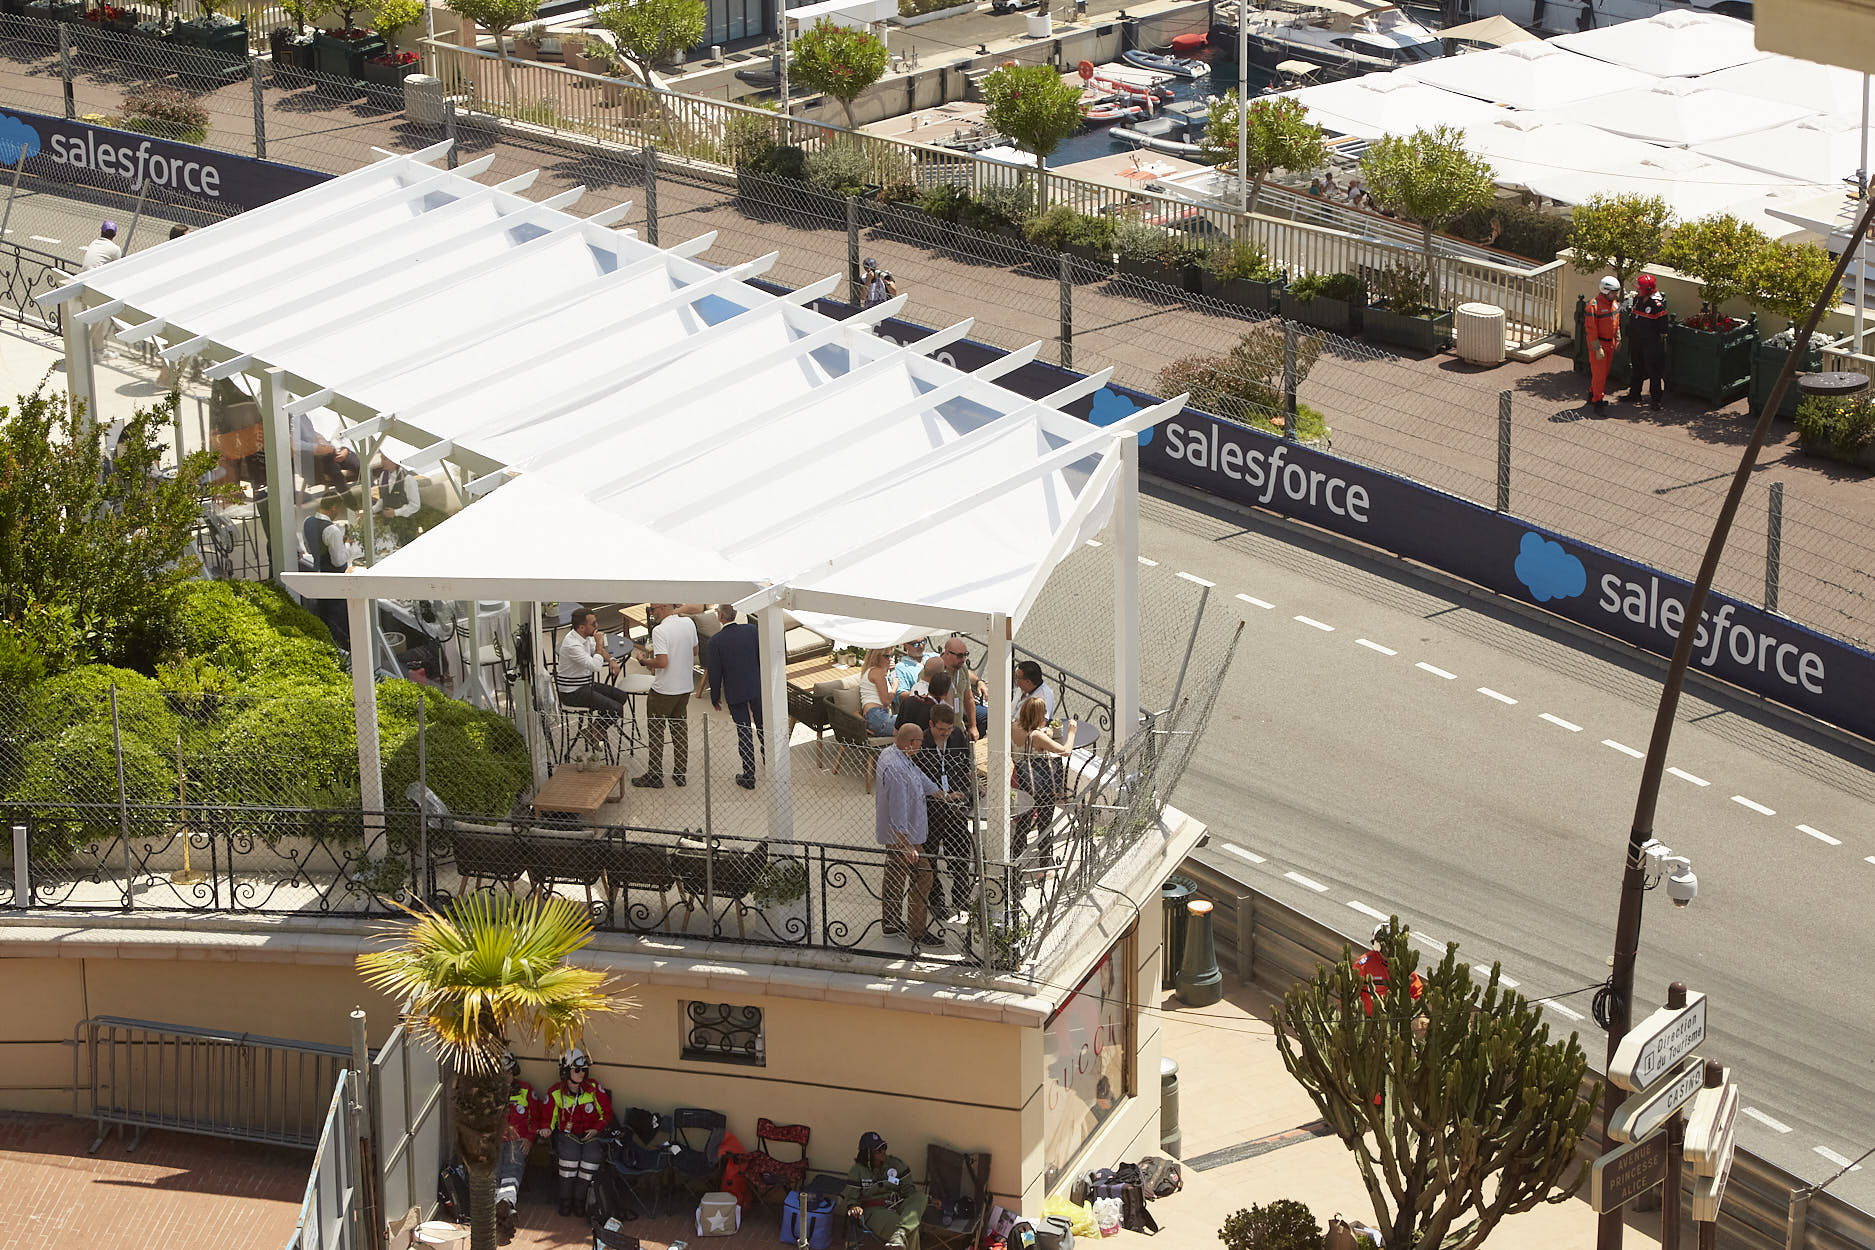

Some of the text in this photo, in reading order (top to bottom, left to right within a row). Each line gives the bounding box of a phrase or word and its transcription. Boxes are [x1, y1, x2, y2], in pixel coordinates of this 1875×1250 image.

[50, 130, 221, 197] salesforce
[1165, 423, 1370, 523] salesforce
[1656, 1026, 1702, 1070] du Tourisme
[1657, 1014, 1697, 1053] Direction
[1049, 1015, 1112, 1111] GUCCI
[1666, 1070, 1701, 1109] CASINO
[1609, 1154, 1659, 1191] PRINCESSE
[1618, 1143, 1652, 1171] AVENUE
[1622, 1176, 1647, 1199] ALICE
